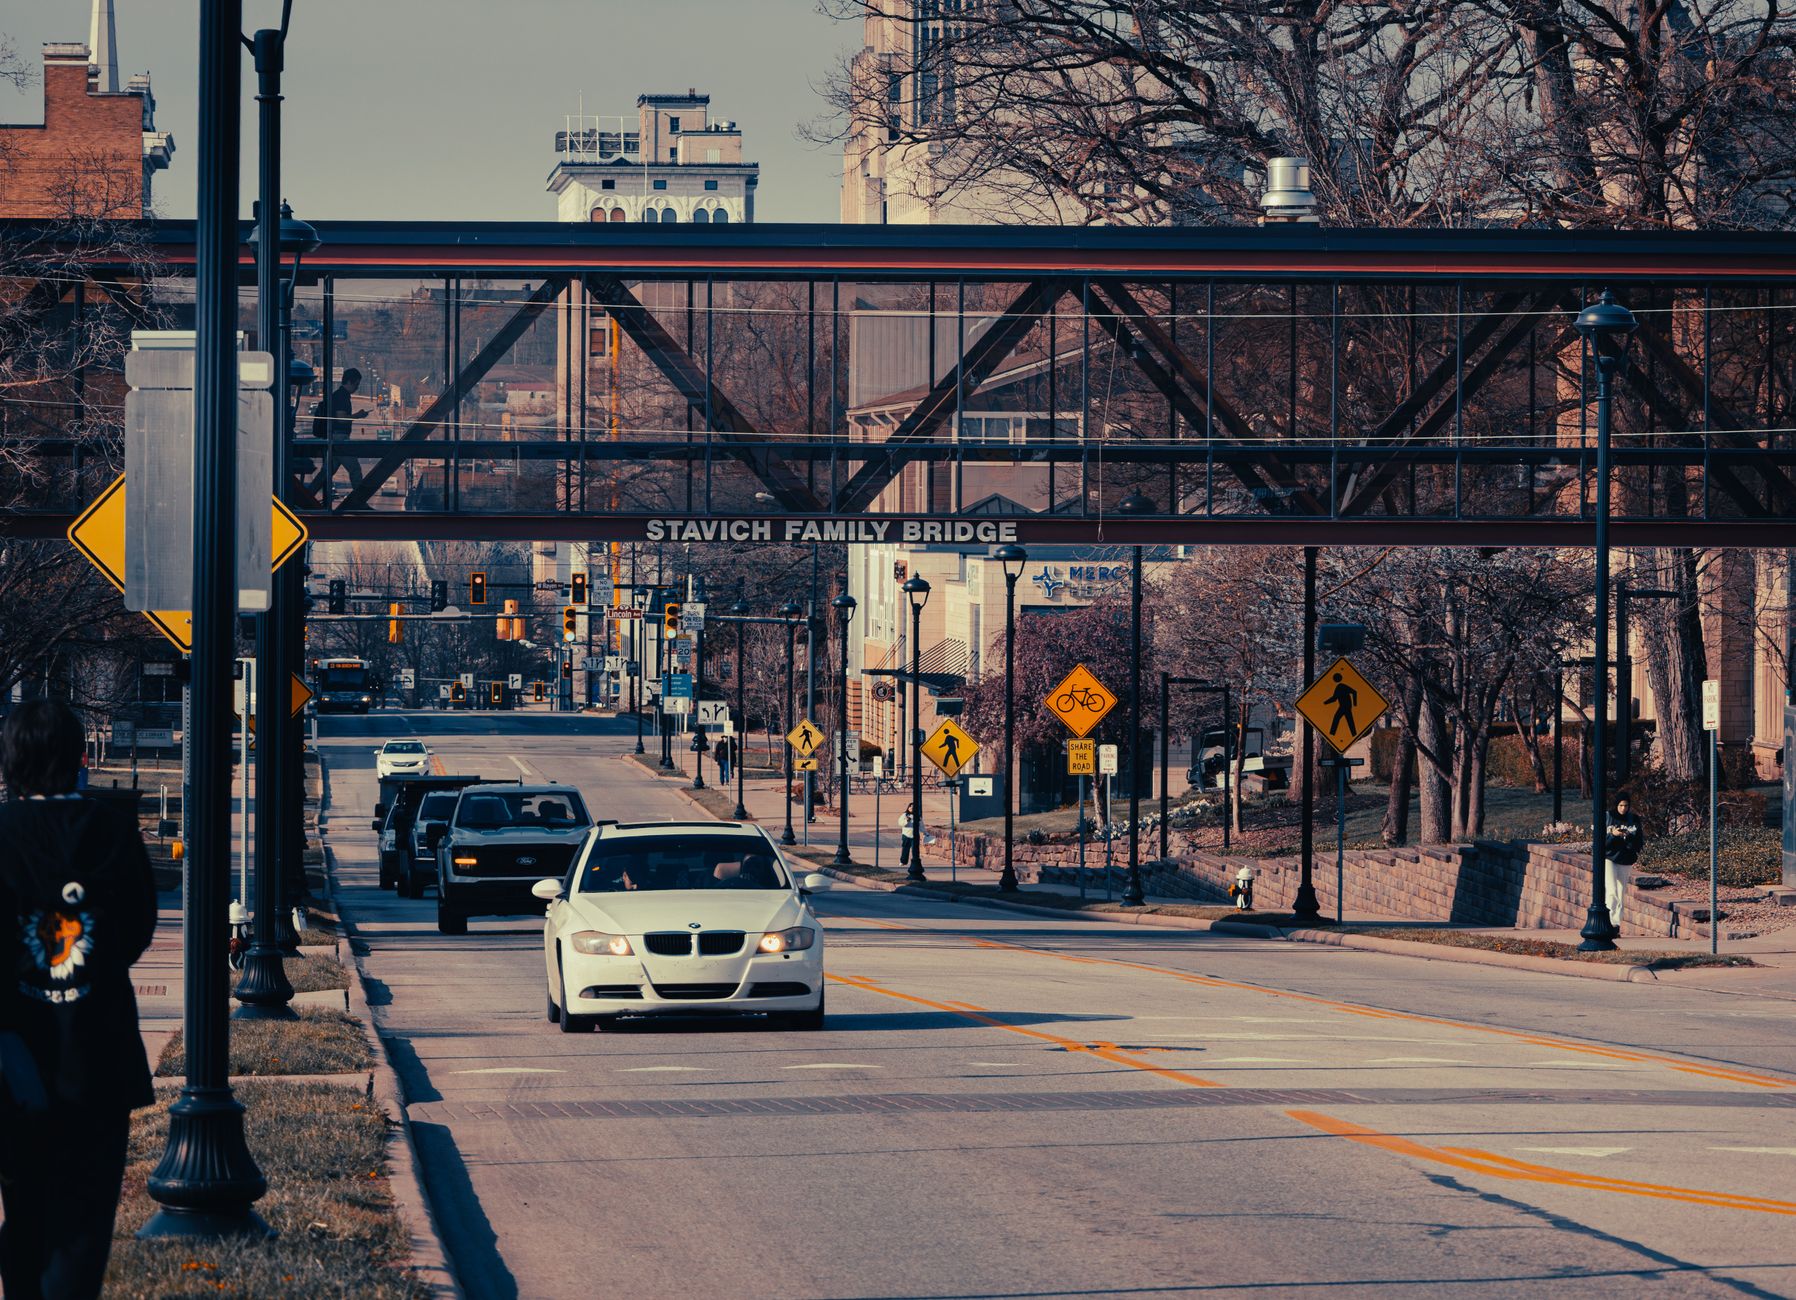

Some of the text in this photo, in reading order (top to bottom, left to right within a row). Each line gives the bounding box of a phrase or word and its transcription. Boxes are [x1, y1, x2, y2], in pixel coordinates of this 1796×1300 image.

[646, 519, 1018, 542] STAVICH FAMILY BRIDGE
[608, 610, 632, 618] Lincoln
[1070, 743, 1092, 751] SHARE
[1072, 763, 1091, 771] ROAD
